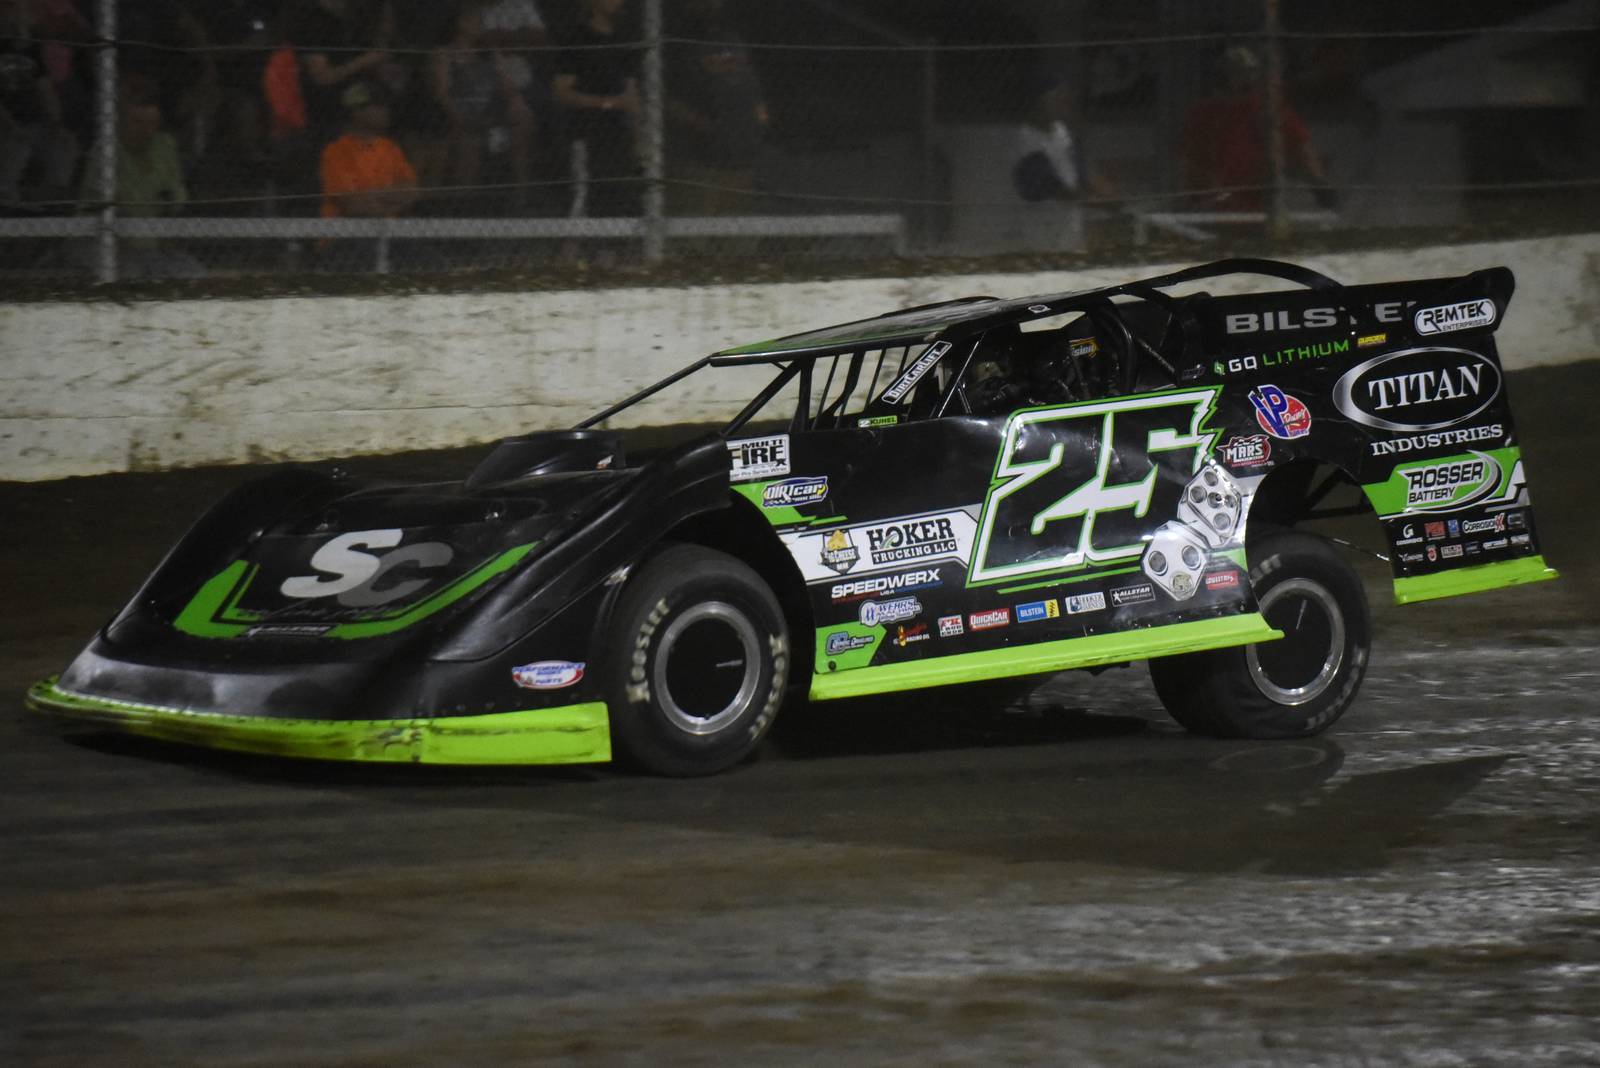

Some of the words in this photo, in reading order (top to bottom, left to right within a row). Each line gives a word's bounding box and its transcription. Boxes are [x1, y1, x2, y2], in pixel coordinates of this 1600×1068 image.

[1423, 302, 1487, 331] REMTEK
[1442, 318, 1488, 332] ENTERPRISES
[1263, 339, 1349, 366] LITHIUM
[1368, 363, 1484, 410] TITAN
[742, 439, 783, 449] MULTI
[1371, 424, 1503, 456] INDUSTRIES
[1227, 443, 1263, 462] MARS
[1405, 462, 1484, 490] ROSSER
[767, 483, 823, 500] DIRTcar
[1409, 487, 1455, 504] BATTERY
[866, 517, 954, 551] HOKER
[873, 546, 932, 562] TRUCKING
[934, 541, 956, 553] LLC
[280, 528, 454, 607] SC
[831, 568, 940, 598] SPEEDWERX
[1119, 586, 1151, 597] ALLSTAR
[1020, 606, 1045, 618] BILSTEIN
